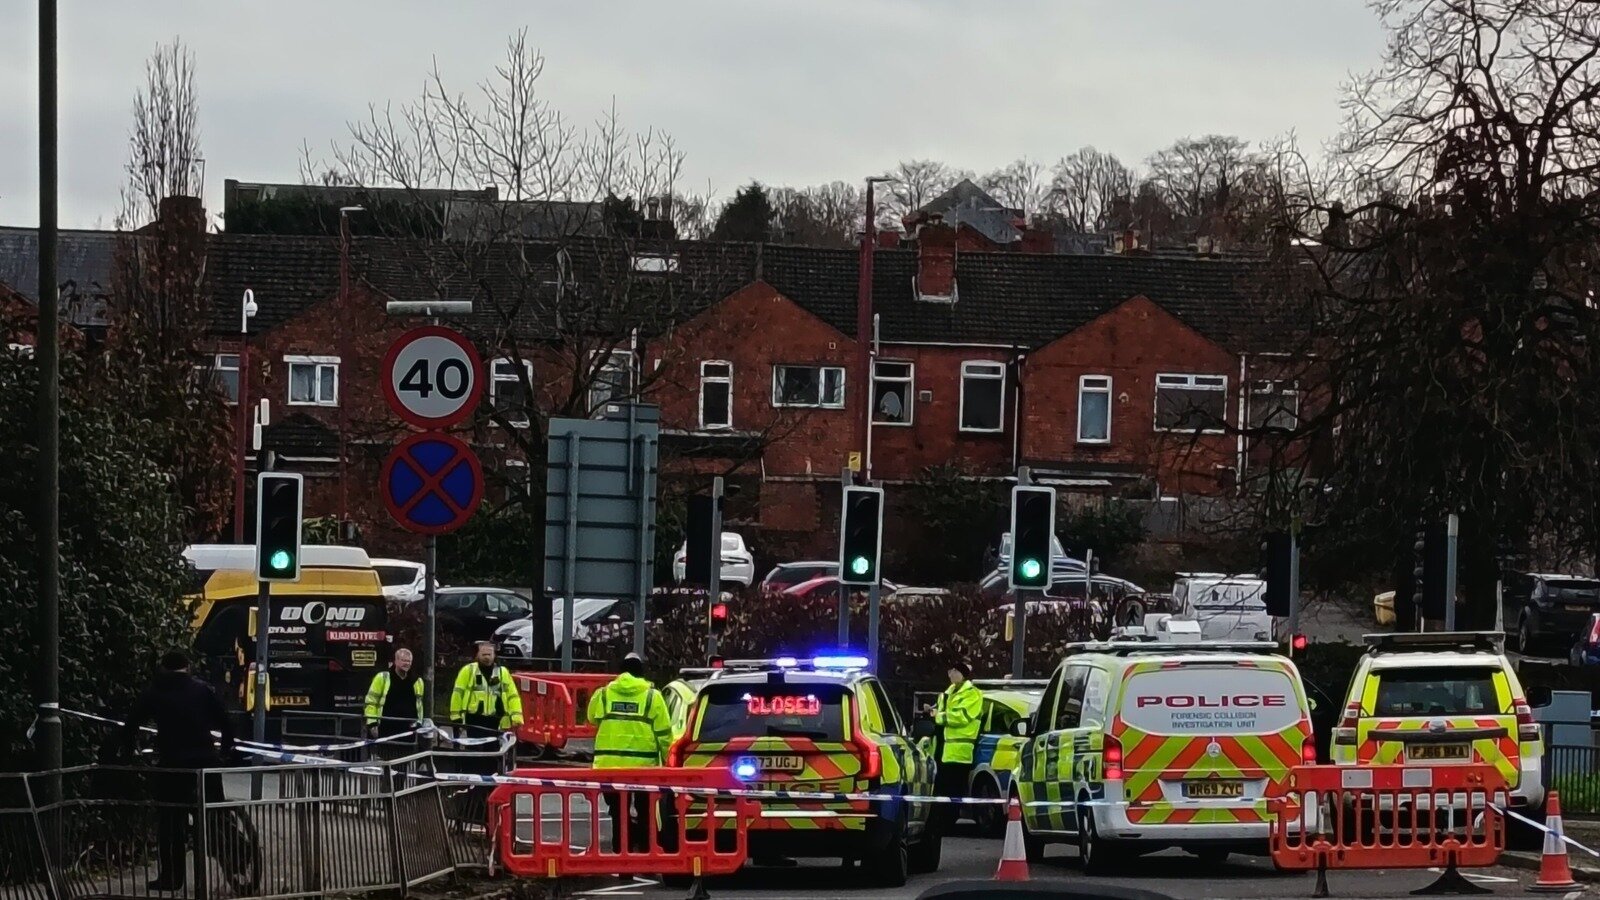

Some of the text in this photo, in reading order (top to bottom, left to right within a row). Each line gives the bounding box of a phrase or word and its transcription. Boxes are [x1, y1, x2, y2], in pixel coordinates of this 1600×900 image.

[399, 358, 469, 399] 40
[280, 601, 366, 625] BOND
[747, 696, 821, 715] CLOSED
[1136, 695, 1287, 708] POLICE
[1170, 711, 1257, 720] FORENSIC COLLISION
[1171, 720, 1256, 728] INVESTIGATION UNIT
[775, 757, 799, 768] UGJ
[1189, 783, 1219, 795] WR69
